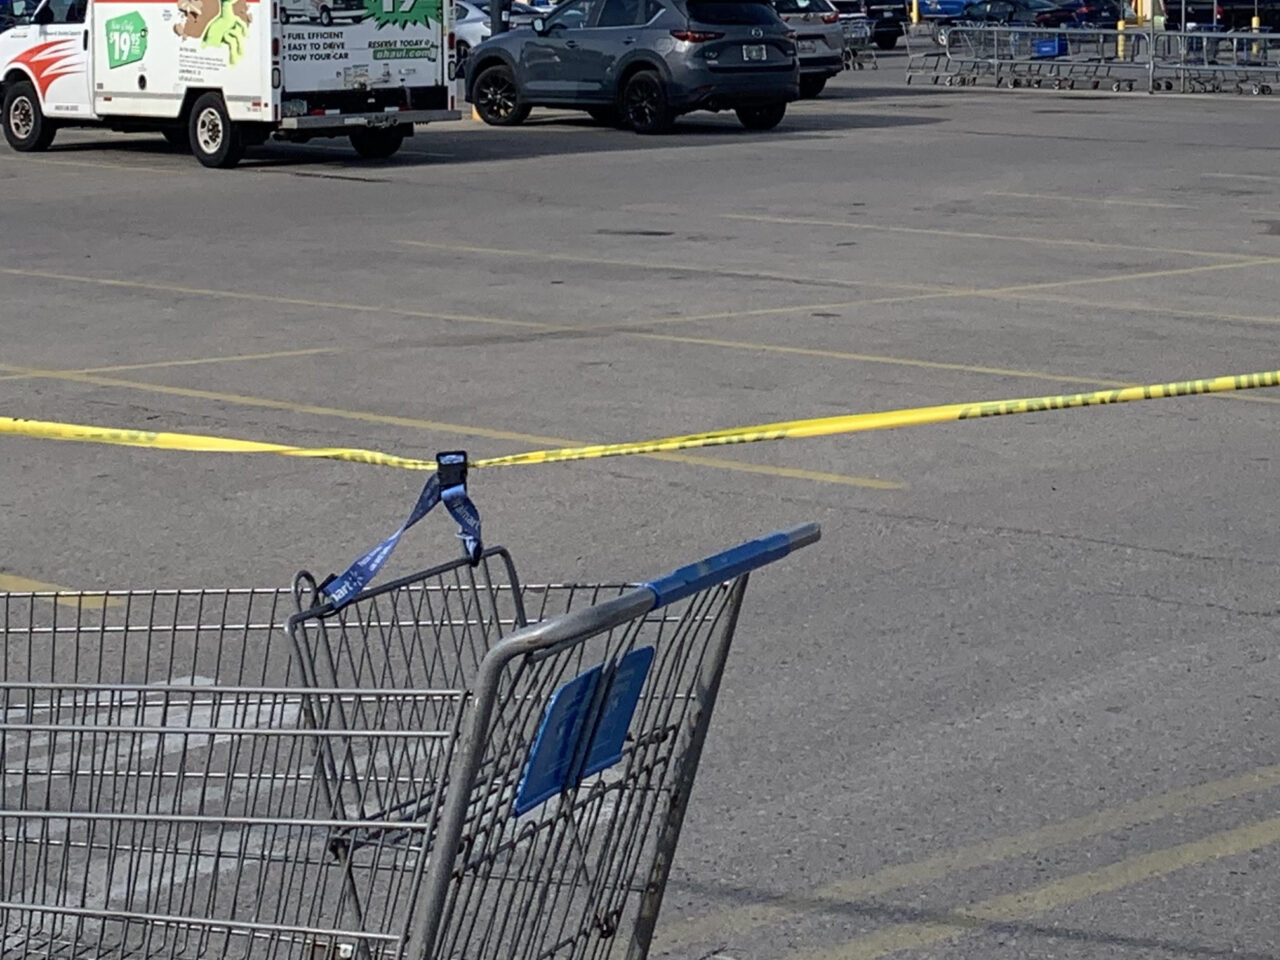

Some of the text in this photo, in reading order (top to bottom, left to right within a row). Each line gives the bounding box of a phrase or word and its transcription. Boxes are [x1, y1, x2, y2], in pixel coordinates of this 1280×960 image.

[288, 32, 305, 40] FUEL
[288, 43, 307, 51] EASY
[310, 42, 320, 50] TO
[288, 53, 306, 61] TOW
